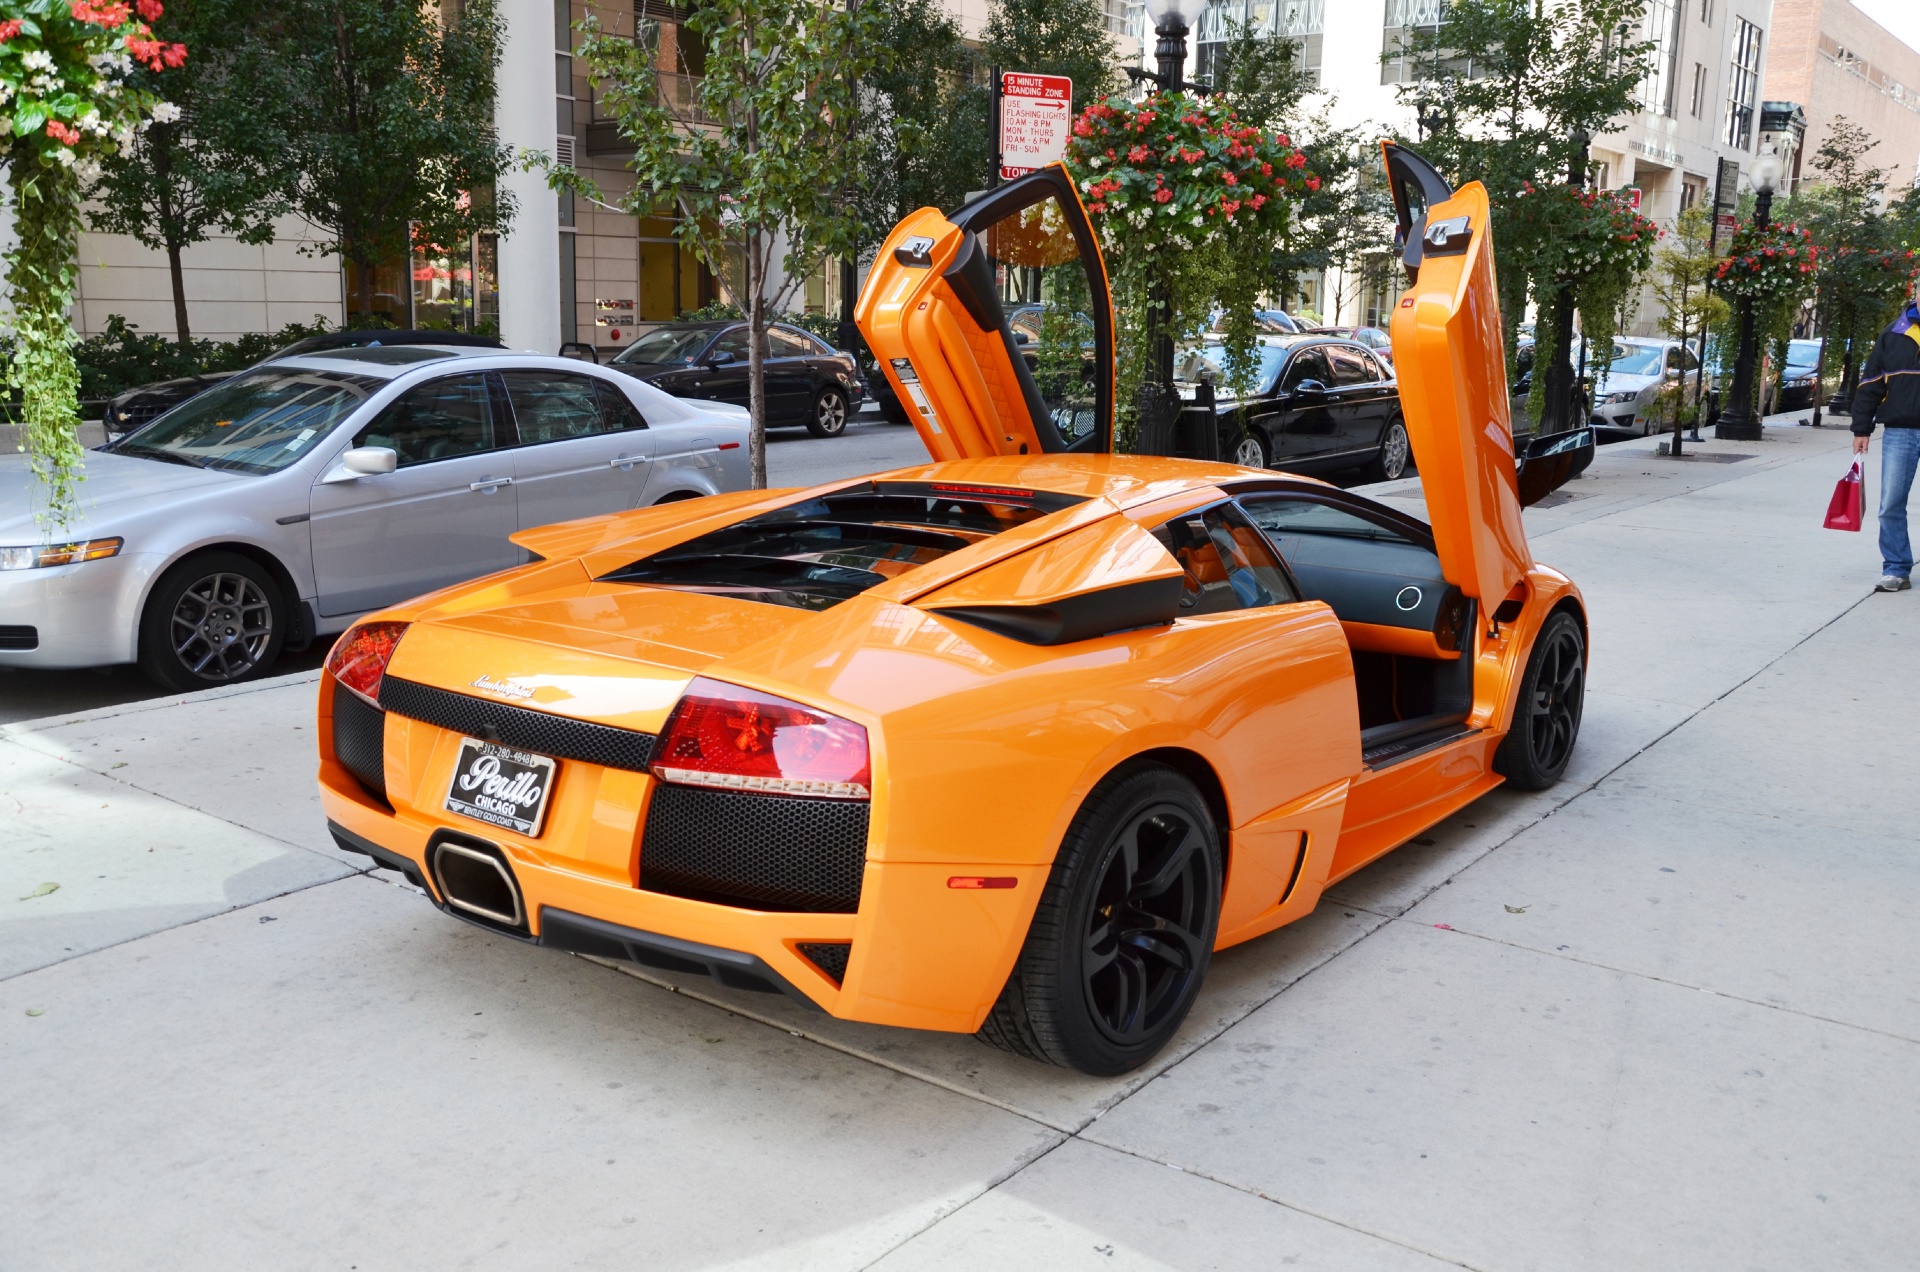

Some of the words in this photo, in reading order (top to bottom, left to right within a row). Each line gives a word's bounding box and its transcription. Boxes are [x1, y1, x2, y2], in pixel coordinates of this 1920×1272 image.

[1007, 76, 1015, 85] 15
[1017, 77, 1043, 87] MINUTE
[1007, 86, 1041, 96] STANDING
[1045, 88, 1064, 98] ZONE
[1006, 100, 1021, 108] USE
[1006, 109, 1041, 119] FLASHING
[1042, 111, 1067, 120] LIGHTS
[1006, 118, 1014, 126] 10
[1006, 127, 1022, 135] MON
[1030, 128, 1054, 137] THURS
[1006, 135, 1013, 143] 10
[1032, 137, 1038, 145] 6
[1005, 144, 1018, 152] FRI
[1024, 145, 1040, 153] SUN
[483, 743, 532, 764] 312-280-4848
[459, 755, 541, 808] Perillo
[475, 794, 516, 816] CHICAGO
[463, 805, 484, 820] BENTLEY
[483, 811, 498, 823] GOLD
[497, 815, 514, 827] COAST
